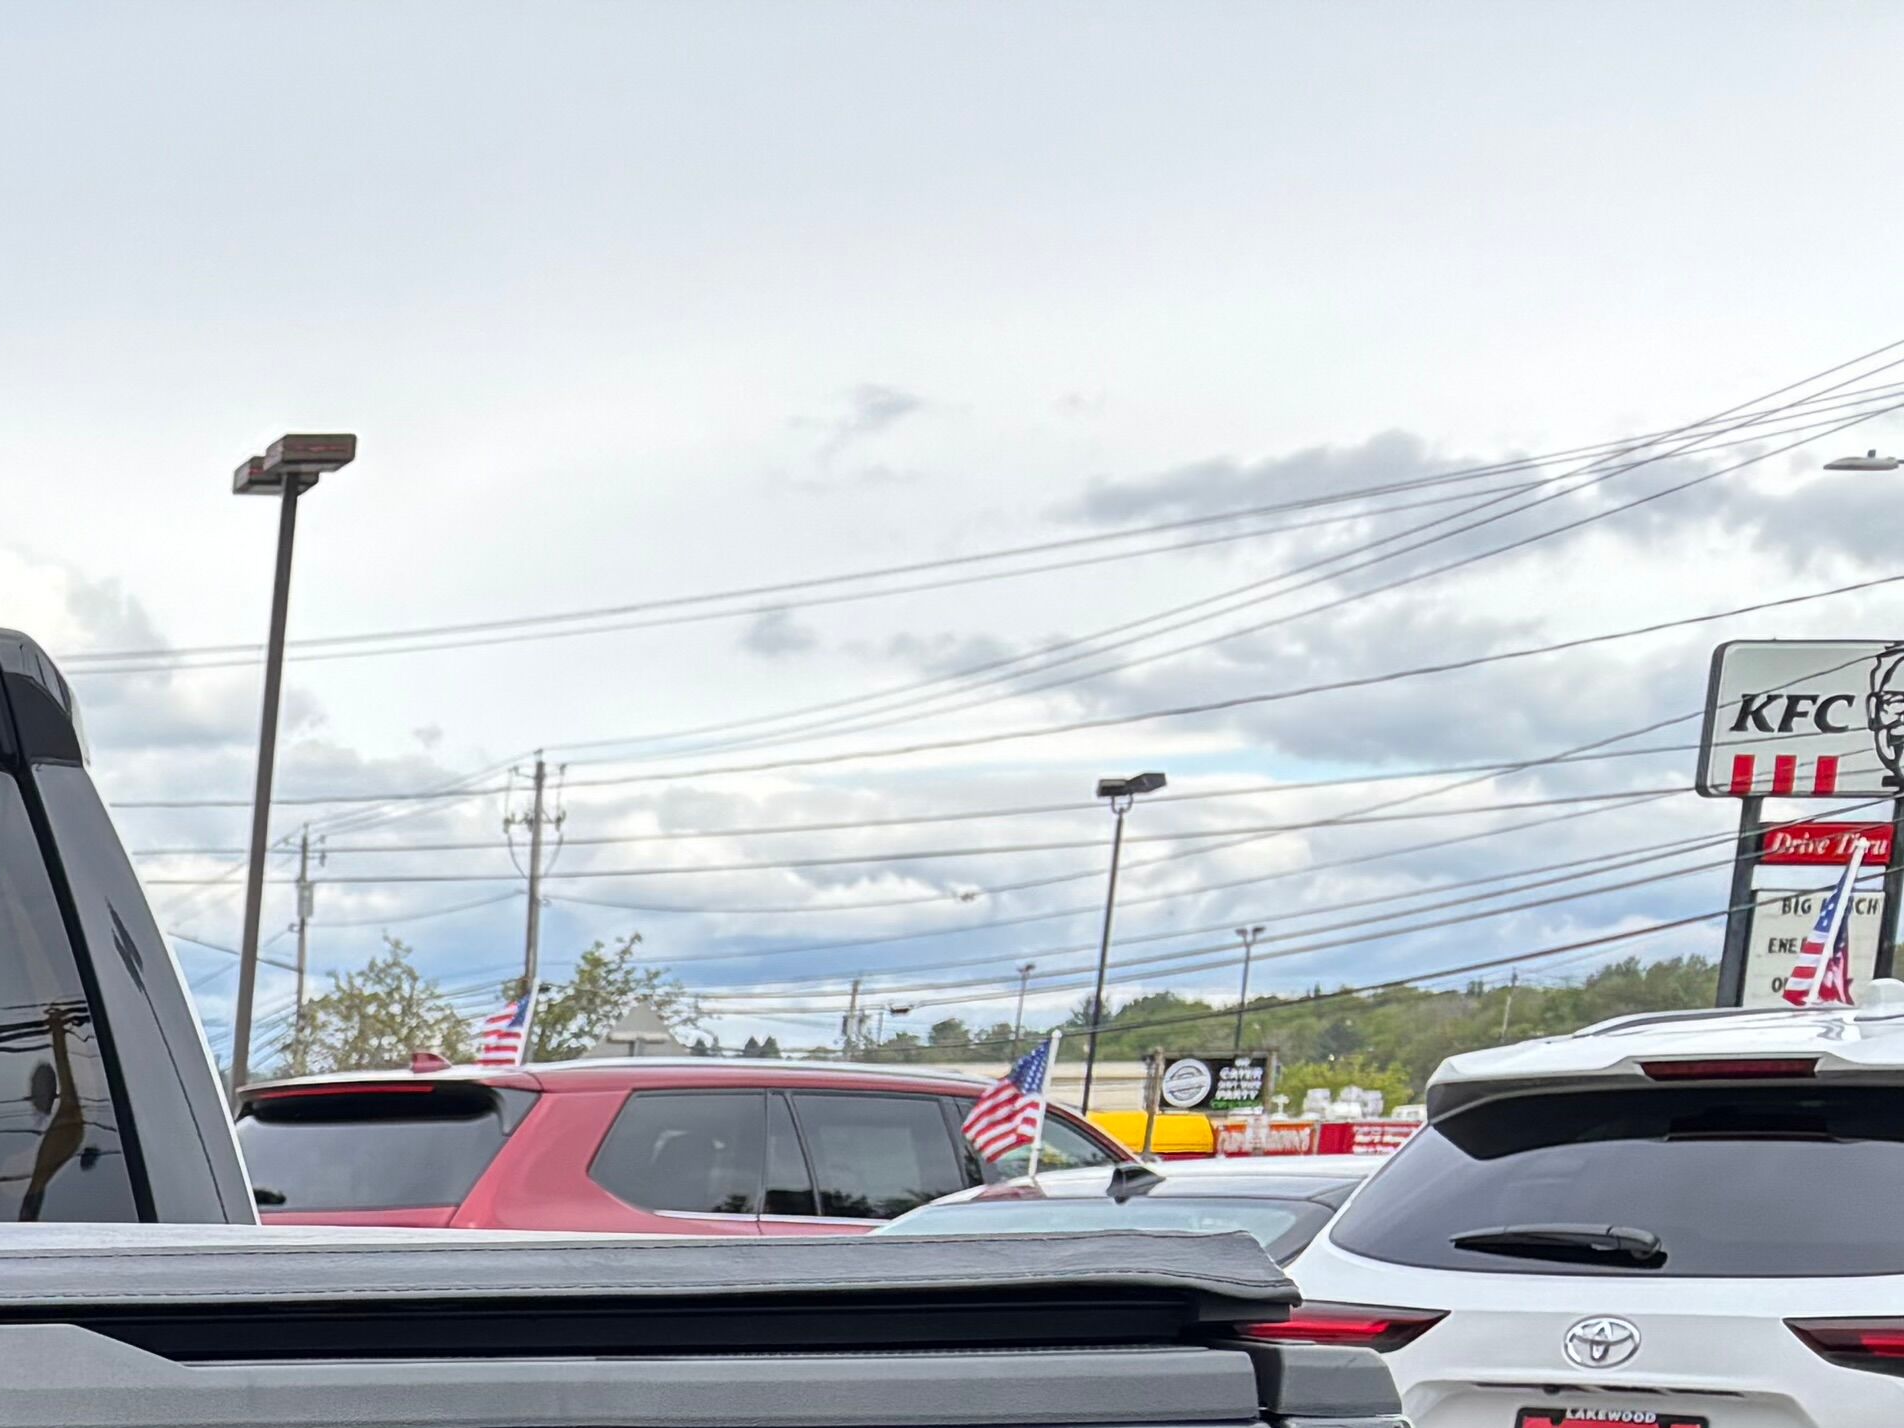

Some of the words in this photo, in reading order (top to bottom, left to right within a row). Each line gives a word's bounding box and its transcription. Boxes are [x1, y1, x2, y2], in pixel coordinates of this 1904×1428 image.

[1729, 693, 1856, 733] KFC
[1770, 831, 1830, 854] Drive
[1782, 898, 1812, 915] BIG
[1565, 1408, 1657, 1424] LAKEWOOD
